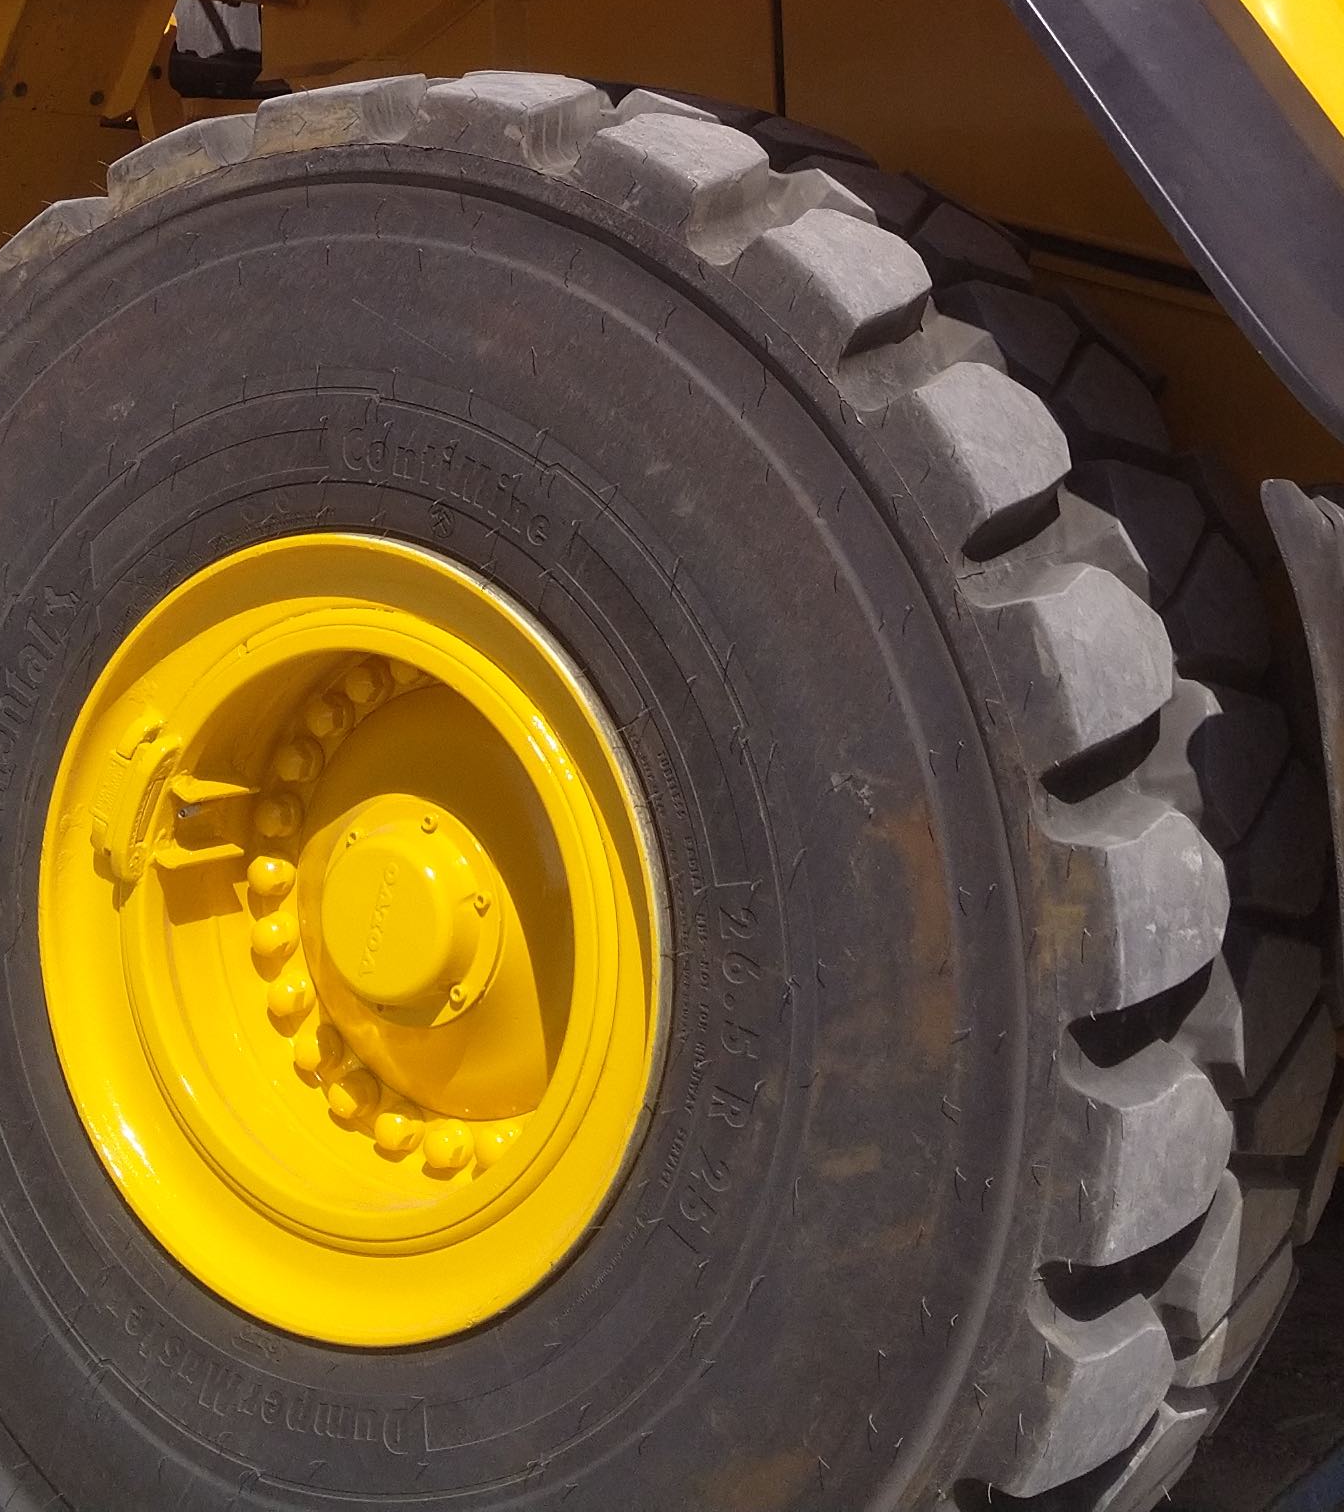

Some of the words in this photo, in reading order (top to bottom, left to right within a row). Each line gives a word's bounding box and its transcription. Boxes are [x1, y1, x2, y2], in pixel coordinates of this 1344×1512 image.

[719, 905, 761, 1060] 26.5
[707, 1084, 751, 1129] R
[679, 1145, 733, 1236] 25
